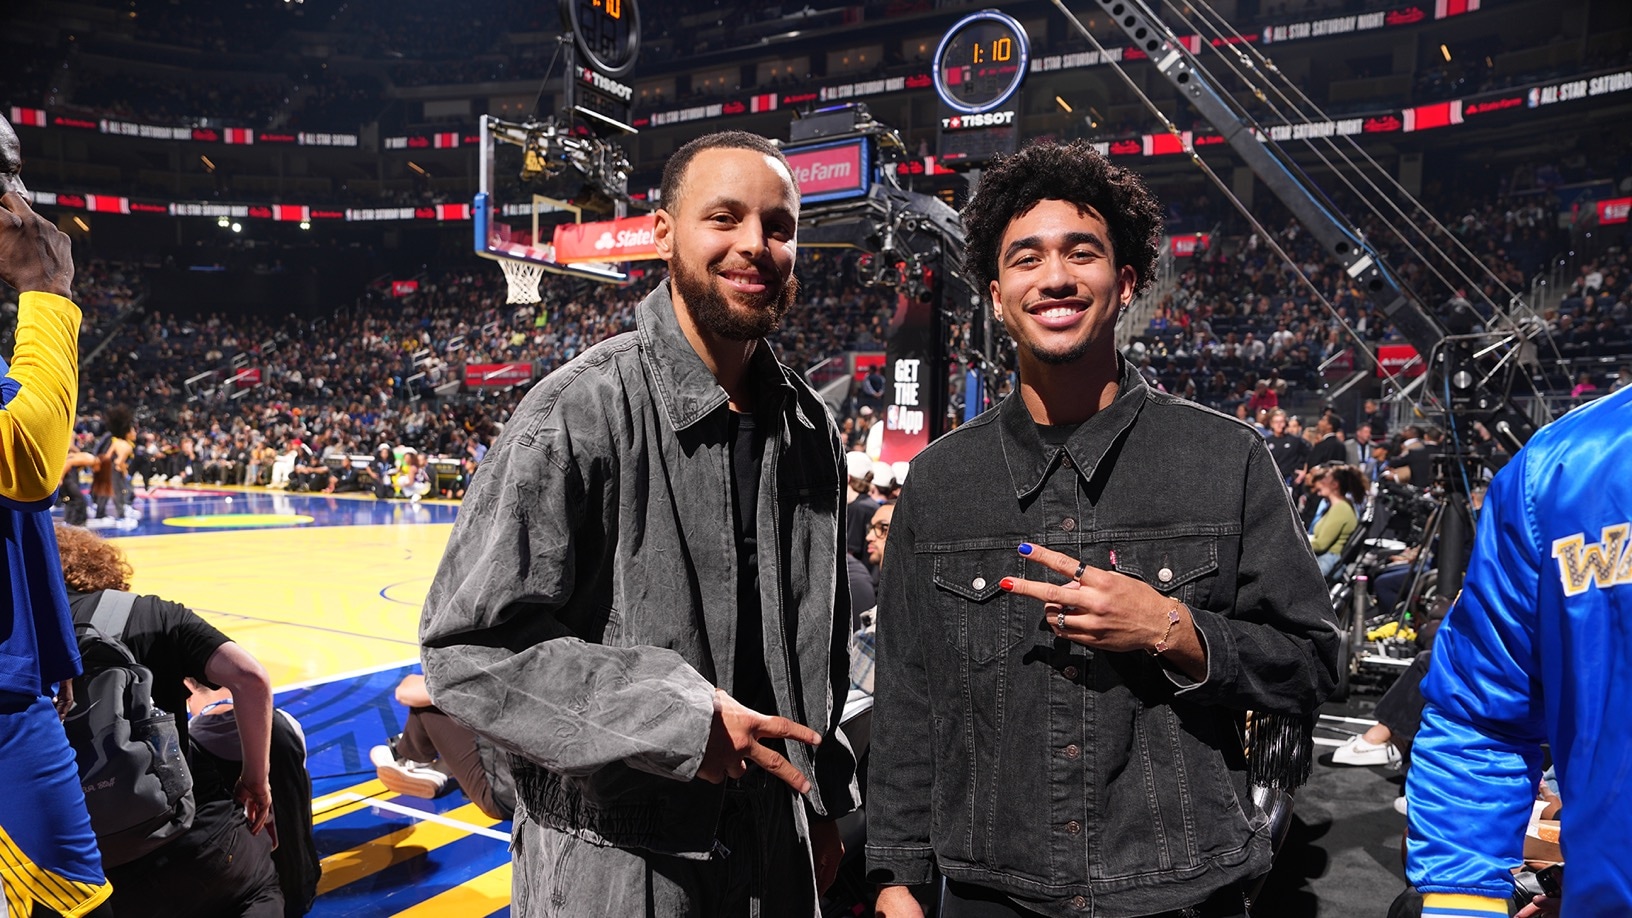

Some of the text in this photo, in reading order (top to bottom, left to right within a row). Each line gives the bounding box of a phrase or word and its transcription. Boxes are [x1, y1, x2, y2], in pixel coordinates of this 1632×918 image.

[1312, 16, 1357, 37] SATURDAY
[1357, 11, 1386, 30] NIGHT
[973, 38, 1011, 64] 1:10
[1062, 51, 1099, 69] SATURDAY
[592, 71, 633, 100] TISSOT
[854, 80, 885, 96] SATURDAY
[885, 76, 905, 91] NIGHT
[961, 110, 1015, 128] TISSOT
[793, 161, 851, 183] teFarm
[615, 228, 655, 248] State
[895, 359, 920, 382] GET
[894, 383, 919, 405] THE
[898, 406, 924, 435] App
